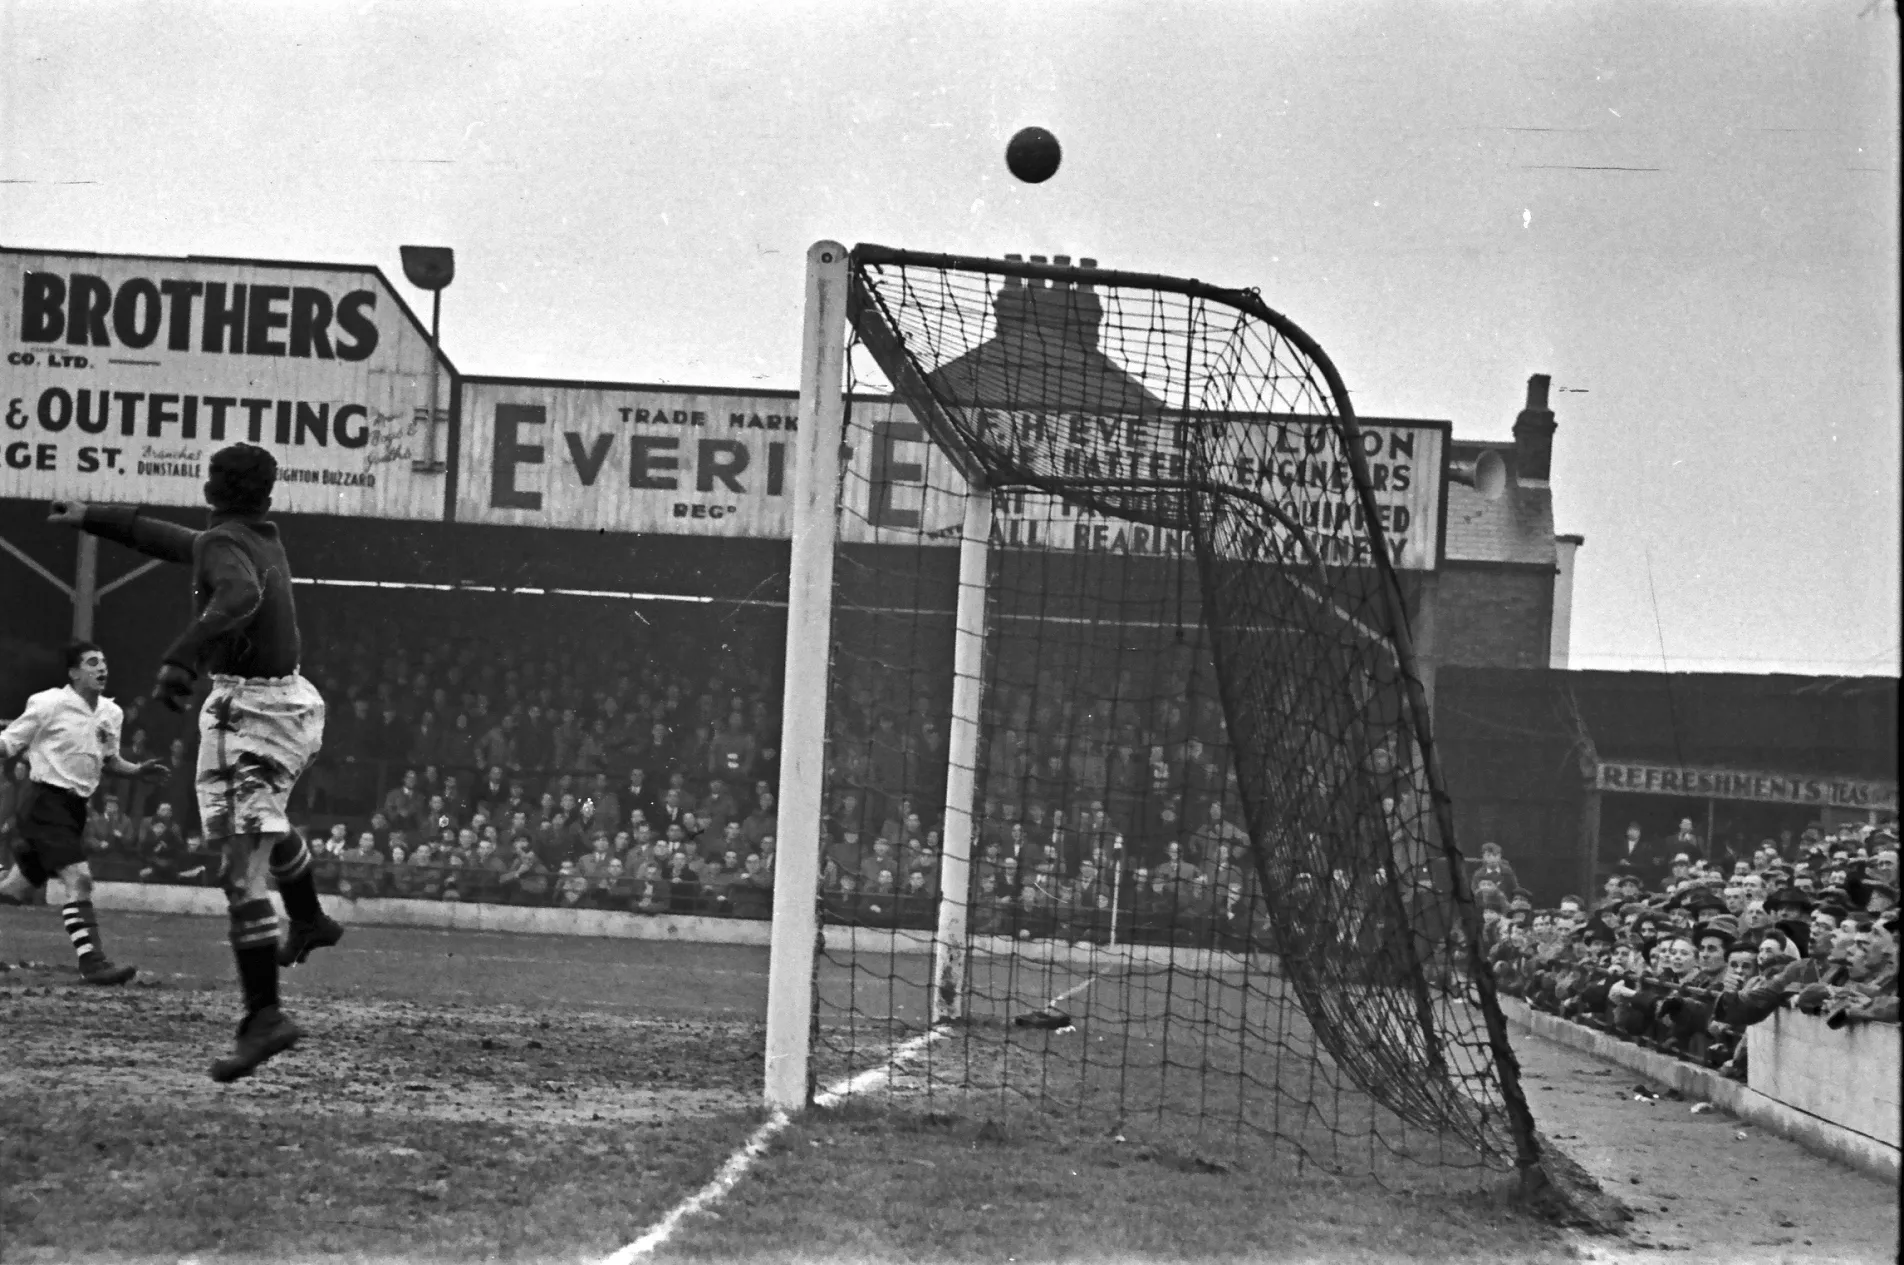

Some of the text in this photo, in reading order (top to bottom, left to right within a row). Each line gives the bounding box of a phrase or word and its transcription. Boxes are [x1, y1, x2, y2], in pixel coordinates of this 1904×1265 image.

[21, 272, 380, 361] BROTHERS
[7, 352, 94, 369] CO. LTD.
[5, 398, 29, 430] &
[37, 387, 369, 448] OUTFITTING
[618, 408, 798, 431] TRADE MARK
[1276, 421, 1414, 460] LUON
[0, 442, 125, 474] GE ST.
[137, 460, 375, 488] DUNSTABLE IGHTON BUZZARD
[491, 403, 923, 528] EVERIE
[1238, 457, 1411, 491] ENGINERS
[1603, 766, 1823, 800] REFRESHMENTS
